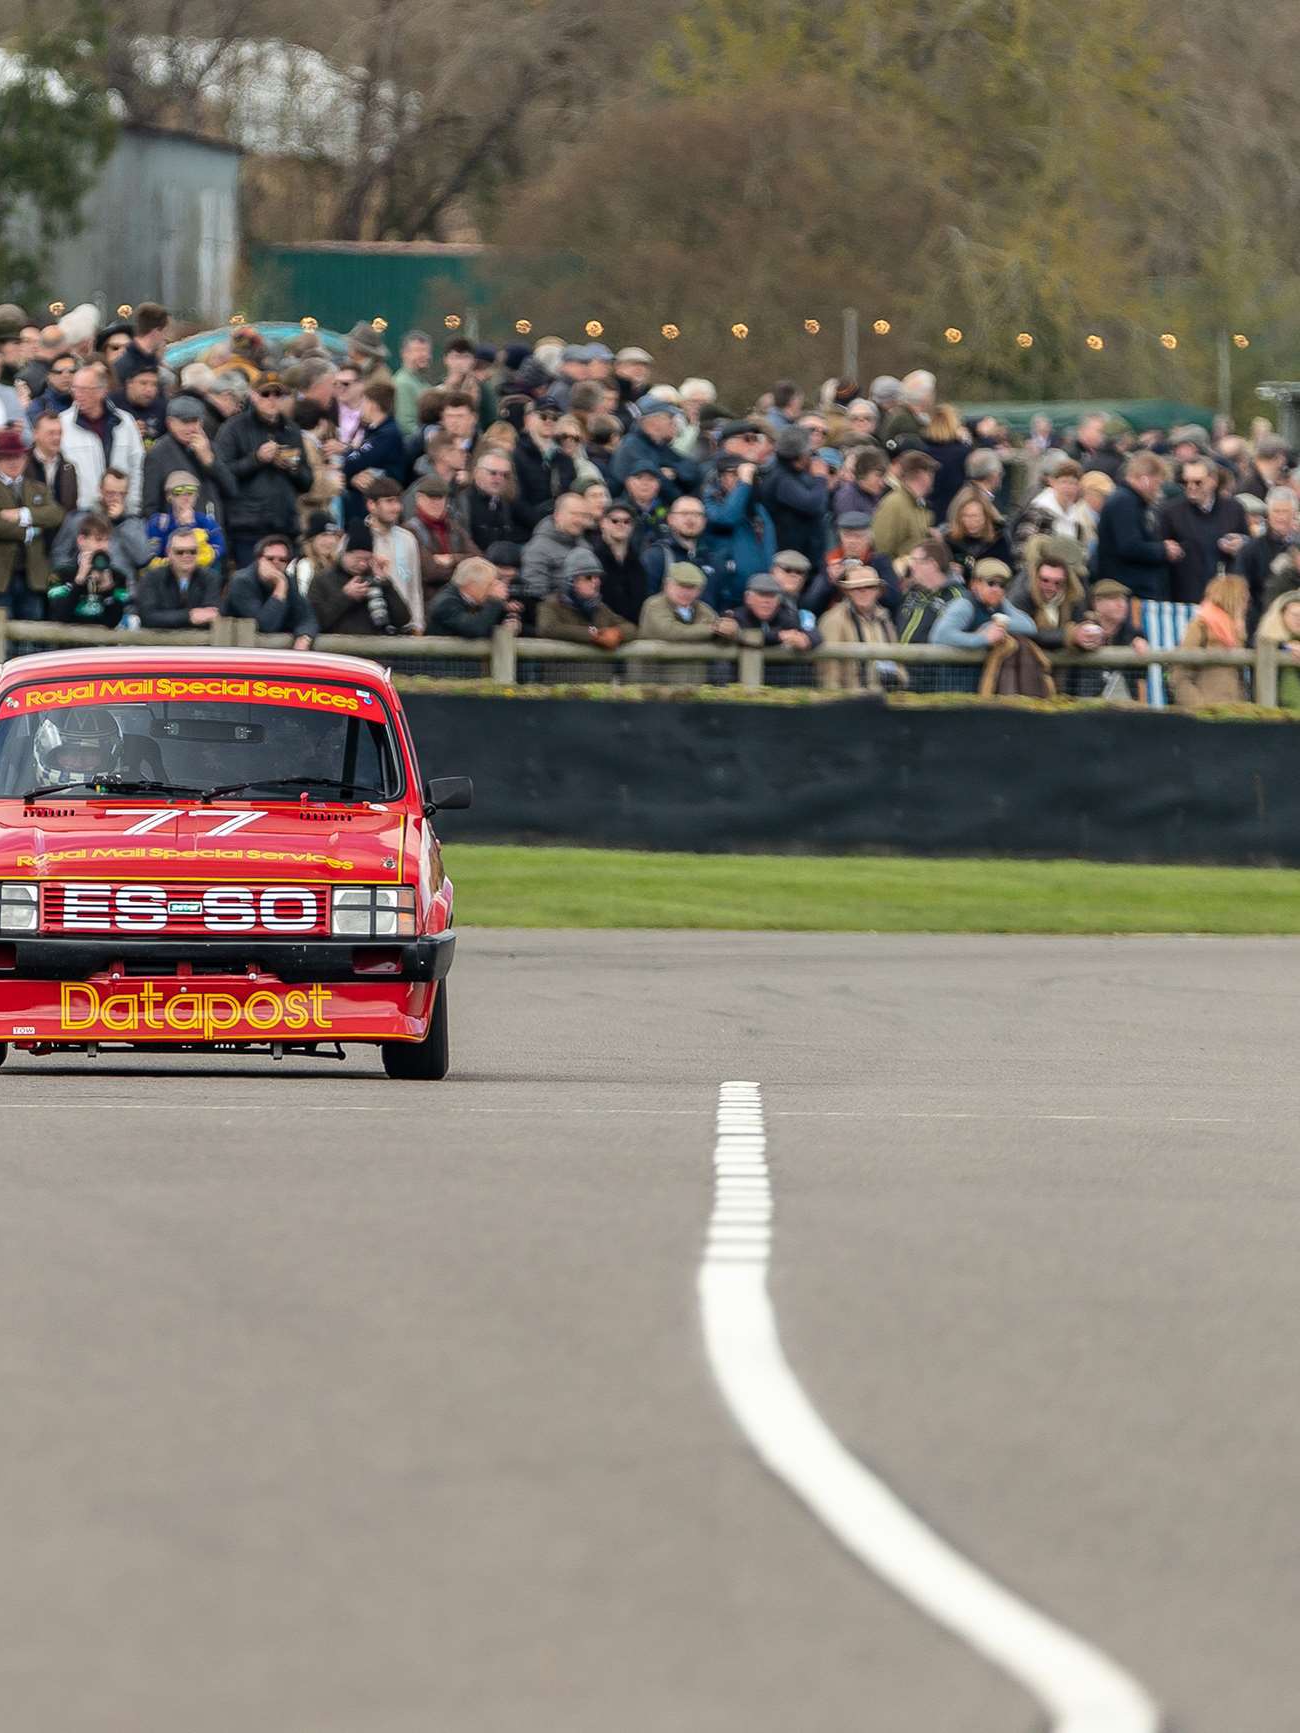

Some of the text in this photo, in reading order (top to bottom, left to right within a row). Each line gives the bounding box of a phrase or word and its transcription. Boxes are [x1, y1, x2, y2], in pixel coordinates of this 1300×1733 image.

[26, 678, 359, 711] Royal Mail Special Services
[105, 809, 268, 837] 77
[16, 848, 354, 870] Royal Mail Special Services
[61, 981, 332, 1041] Datapost
